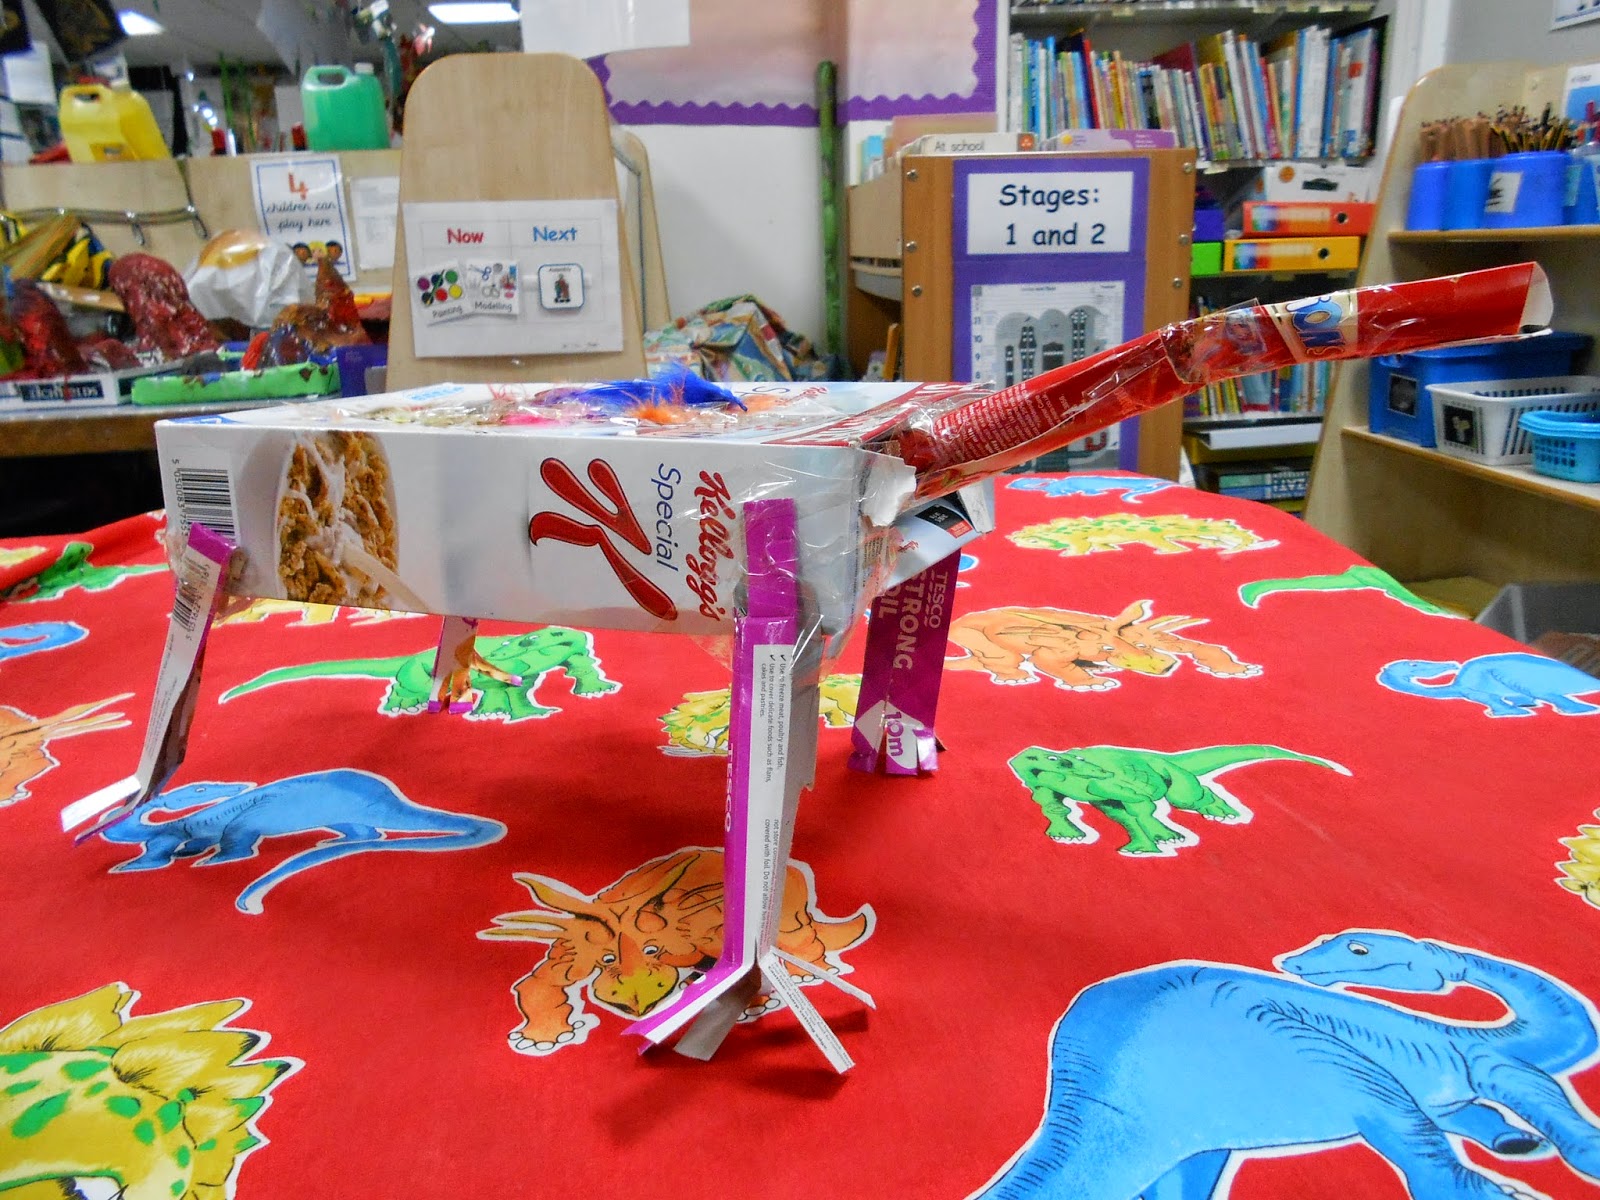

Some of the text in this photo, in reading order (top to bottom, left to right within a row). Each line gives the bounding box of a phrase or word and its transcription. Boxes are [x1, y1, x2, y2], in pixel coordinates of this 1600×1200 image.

[951, 140, 985, 151] school
[288, 172, 309, 200] 4
[1000, 184, 1100, 213] Stages:
[266, 201, 310, 214] children
[278, 216, 331, 232] play here
[447, 228, 484, 244] Now
[532, 226, 578, 242] Next
[1006, 222, 1106, 246] 1 and 2
[432, 305, 463, 318] Painting
[474, 301, 513, 312] Modelling
[651, 463, 682, 571] Special
[686, 470, 736, 621] Kellogg's
[928, 572, 948, 629] TESCO
[779, 683, 787, 700] freeze
[767, 700, 775, 721] delicate
[778, 701, 786, 719] meat,
[777, 720, 785, 743] poultry
[885, 711, 904, 757] 10m
[765, 767, 773, 783] flans,
[763, 871, 770, 880] Do
